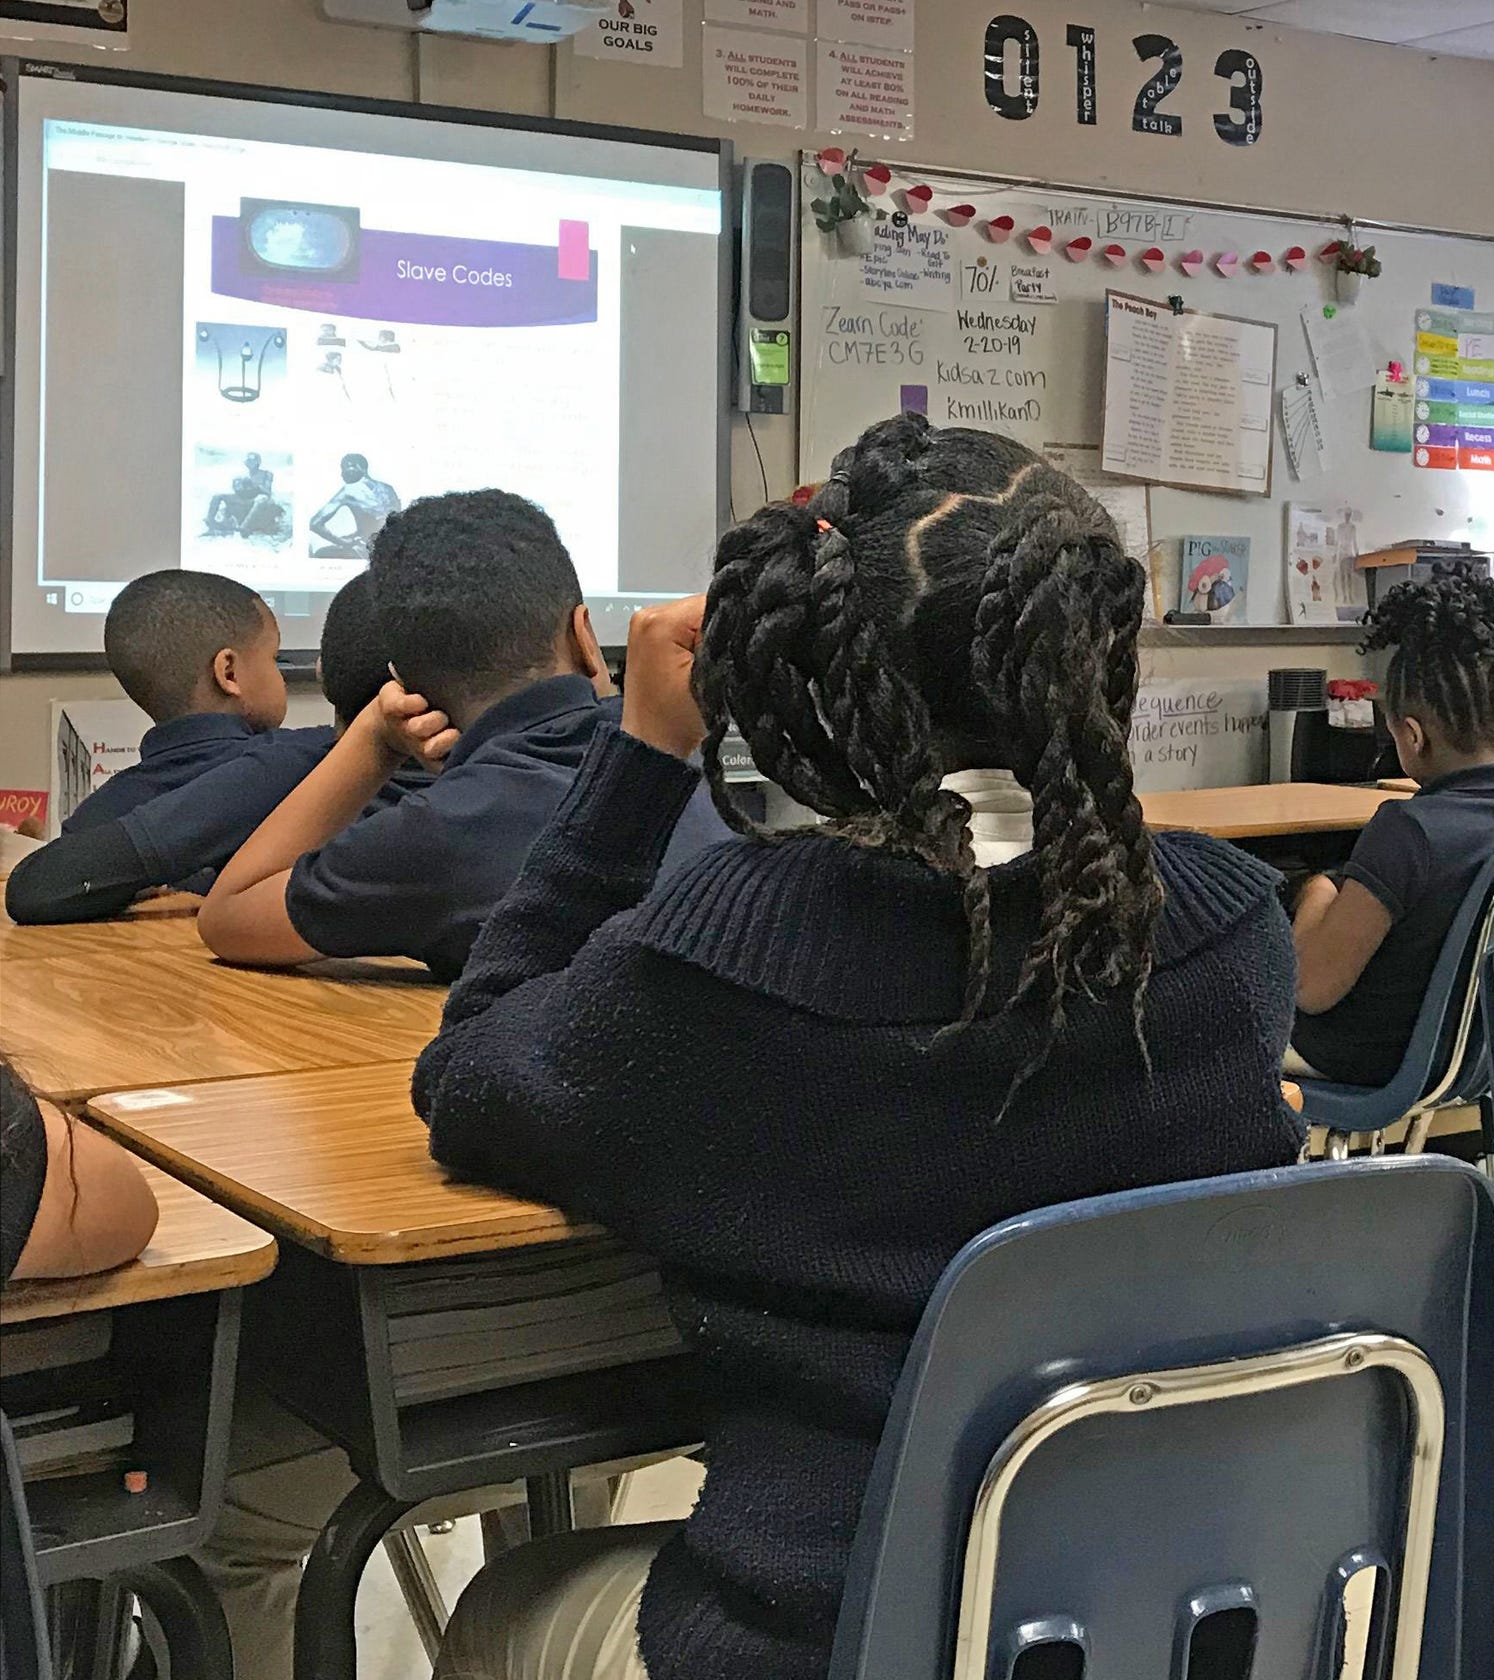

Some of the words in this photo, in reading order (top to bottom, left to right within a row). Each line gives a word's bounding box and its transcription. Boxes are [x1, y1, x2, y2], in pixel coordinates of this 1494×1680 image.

[862, 2, 876, 12] OR
[850, 12, 865, 22] ON
[598, 18, 630, 33] OUR
[633, 23, 658, 37] BIG
[603, 35, 653, 52] GOALS
[715, 49, 726, 59] 3.
[727, 50, 747, 64] ALL
[748, 55, 798, 69] STUDENTS
[828, 50, 838, 60] 4.
[839, 51, 858, 64] ALL
[859, 56, 905, 69] STUDENTS
[724, 64, 748, 74] WILL
[749, 67, 800, 82] COMPLETE
[841, 65, 863, 76] WILL
[864, 69, 904, 82] ACHIEVE
[1023, 29, 1035, 115] silent
[1080, 32, 1095, 123] whisper
[727, 75, 755, 88] 100%
[756, 80, 769, 90] OF
[771, 81, 799, 94] THEIR
[840, 78, 853, 87] AT
[854, 79, 882, 91] LEAST
[1142, 67, 1178, 109] table
[748, 92, 776, 103] DAILY
[835, 89, 849, 98] ON
[850, 91, 867, 101] ALL
[869, 94, 909, 107] READING
[1245, 58, 1258, 145] outside
[732, 103, 792, 118] HOMEWORK.
[849, 103, 869, 113] AND
[870, 106, 896, 117] MATH
[1142, 117, 1173, 135] talk
[907, 224, 931, 250] May
[397, 259, 447, 282] Slave
[452, 265, 513, 288] Codes
[1112, 299, 1124, 310] The
[1145, 309, 1158, 321] Boy
[824, 306, 874, 337] Zearn
[956, 309, 1037, 336] Wednesday
[963, 335, 1021, 356] 2-20-19
[1466, 386, 1491, 399] Lunch
[1464, 431, 1492, 444] Recess
[1470, 453, 1492, 466] Math
[1169, 716, 1219, 739] events
[1144, 750, 1153, 763] a
[1158, 743, 1198, 767] story
